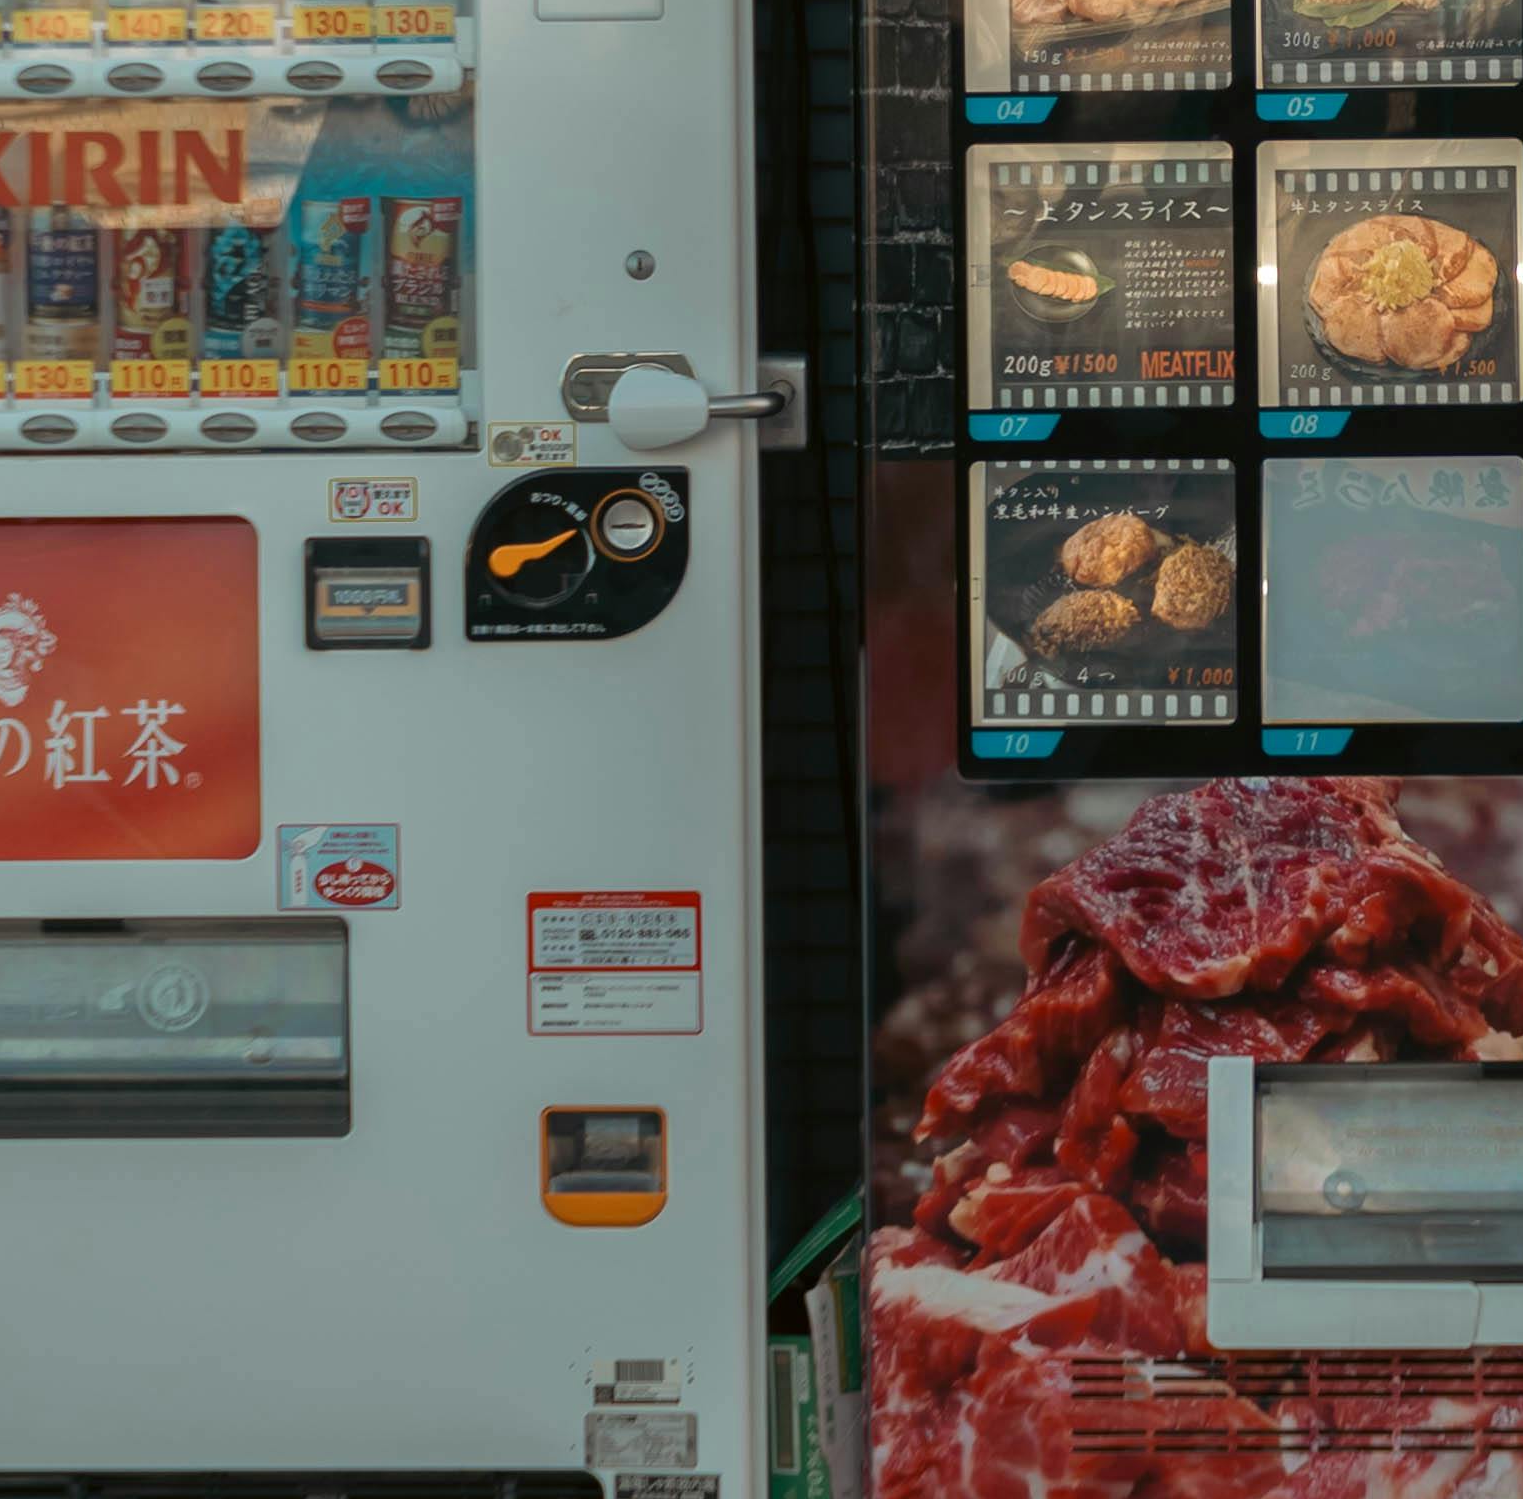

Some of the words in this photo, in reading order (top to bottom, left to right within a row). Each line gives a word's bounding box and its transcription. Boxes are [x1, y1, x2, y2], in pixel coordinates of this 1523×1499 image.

[304, 10, 366, 35] 130円
[385, 9, 447, 34] 130円
[1282, 31, 1321, 48] 300g
[996, 100, 1024, 121] 04
[1287, 96, 1315, 117] 05
[1003, 198, 1231, 223] 〜上タンスライス〜
[210, 363, 272, 388] 110円
[298, 362, 360, 388] 110円
[388, 362, 451, 387] 110円
[1140, 350, 1236, 380] MEATFLIX
[122, 364, 184, 389] 110円
[540, 428, 562, 442] OK
[999, 417, 1028, 437] 07
[1290, 414, 1319, 435] 08
[378, 500, 405, 516] OK
[1003, 732, 1030, 754] 10
[1294, 731, 1320, 751] 11
